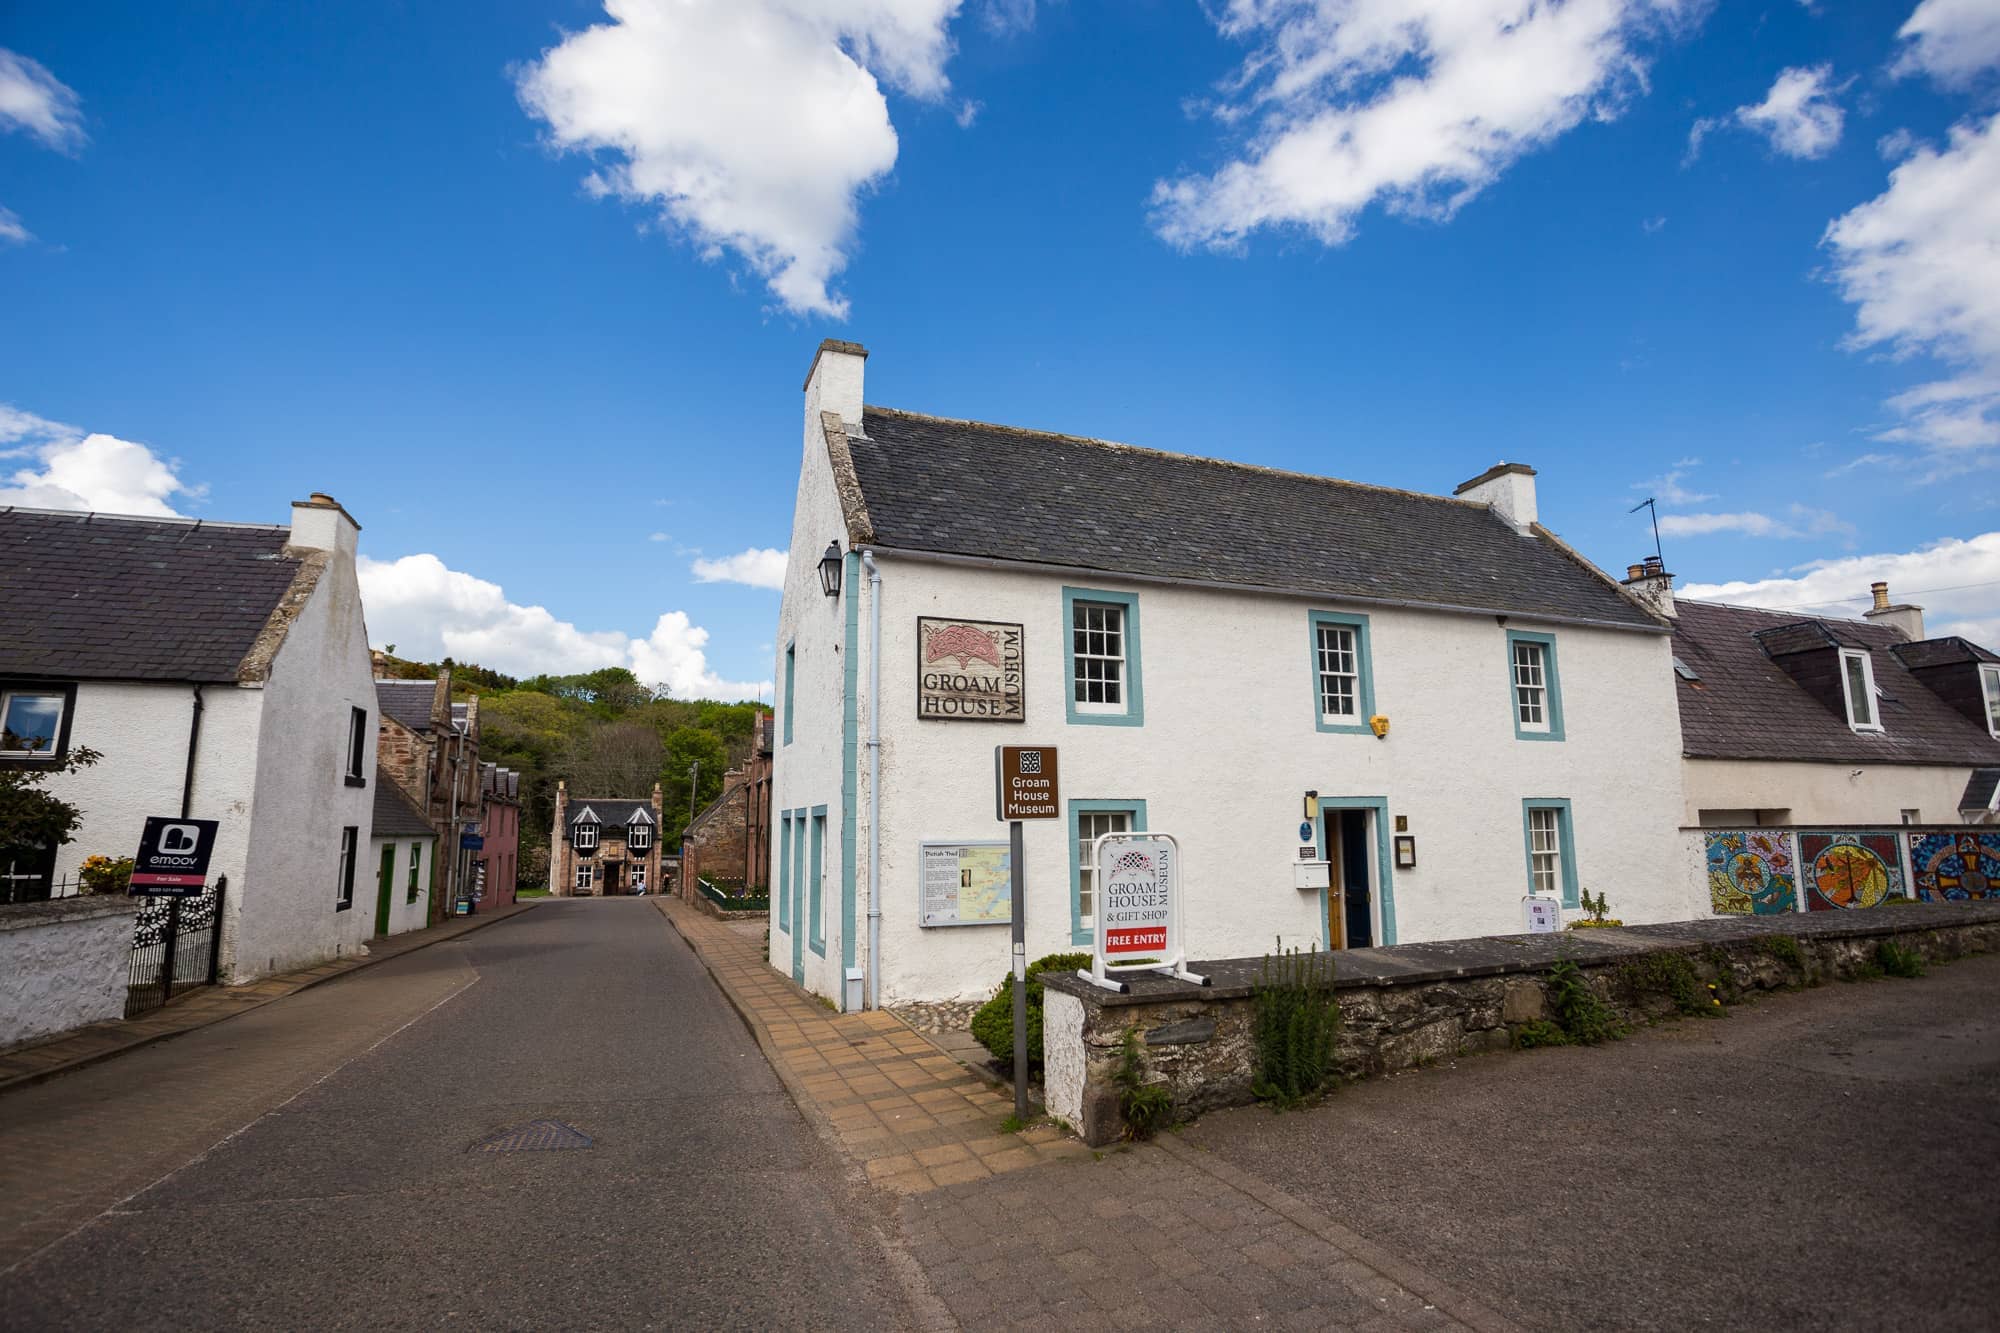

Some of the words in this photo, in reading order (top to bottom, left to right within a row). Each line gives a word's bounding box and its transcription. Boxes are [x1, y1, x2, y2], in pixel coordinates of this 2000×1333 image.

[1004, 630, 1020, 714] MUSEUM
[923, 673, 1001, 693] GROAM
[924, 696, 1002, 716] HOUSE
[1012, 776, 1050, 788] Groam
[1013, 790, 1050, 801] House
[1008, 803, 1055, 815] Museum
[150, 855, 198, 865] emoov
[1159, 850, 1169, 906] MUSEUM
[1108, 882, 1157, 895] GROAM
[1108, 895, 1157, 908] HOUSE
[1106, 912, 1115, 922] &
[1116, 911, 1140, 922] GIFT
[1141, 910, 1168, 920] SHOP
[1107, 935, 1131, 946] FREE
[1133, 933, 1166, 944] ENTRY
